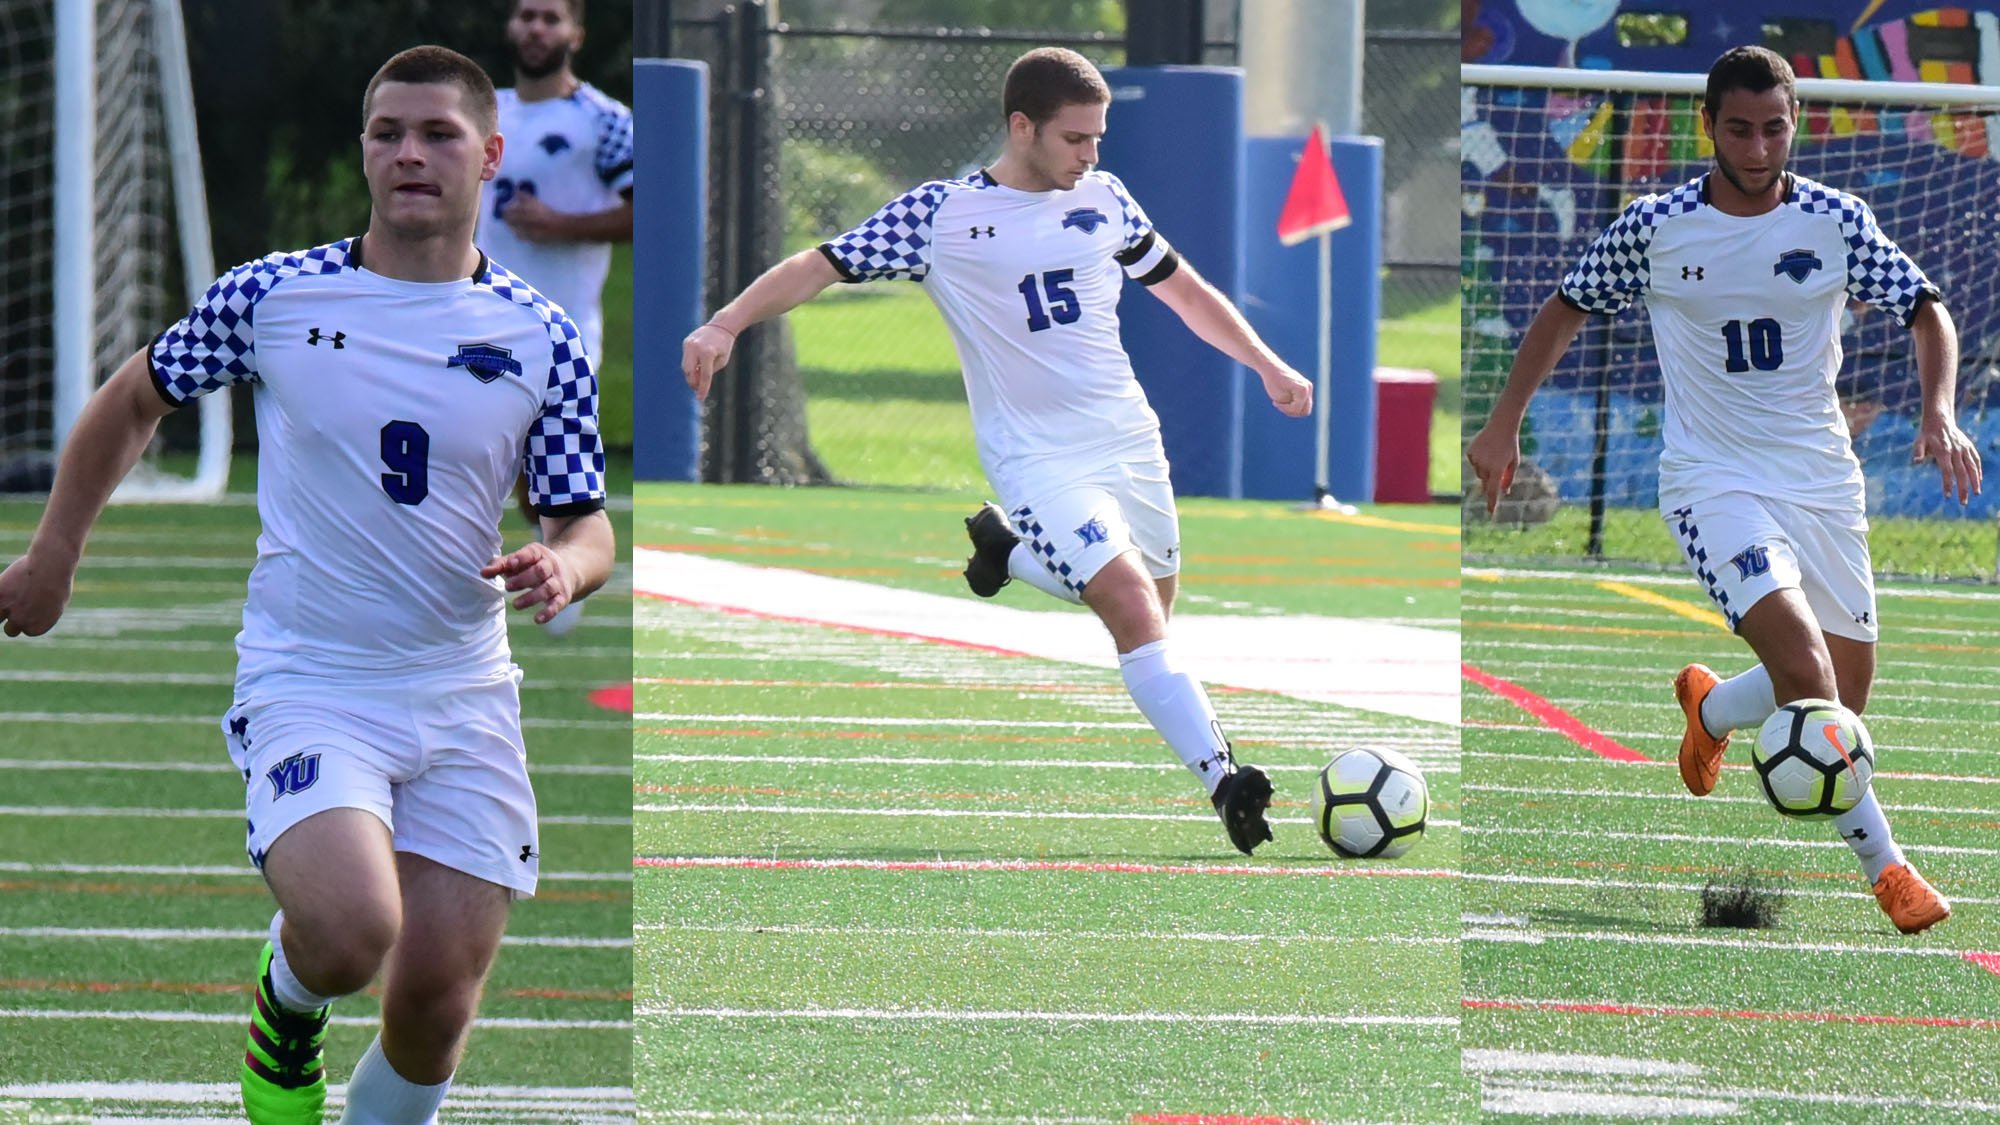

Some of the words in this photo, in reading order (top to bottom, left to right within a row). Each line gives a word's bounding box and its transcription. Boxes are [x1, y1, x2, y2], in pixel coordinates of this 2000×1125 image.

[495, 177, 537, 220] 2
[1018, 268, 1082, 333] 15
[1721, 318, 1783, 373] 10
[380, 419, 430, 506] 9
[1073, 515, 1110, 549] YU
[1729, 544, 1771, 583] YU
[266, 751, 322, 803] YU
